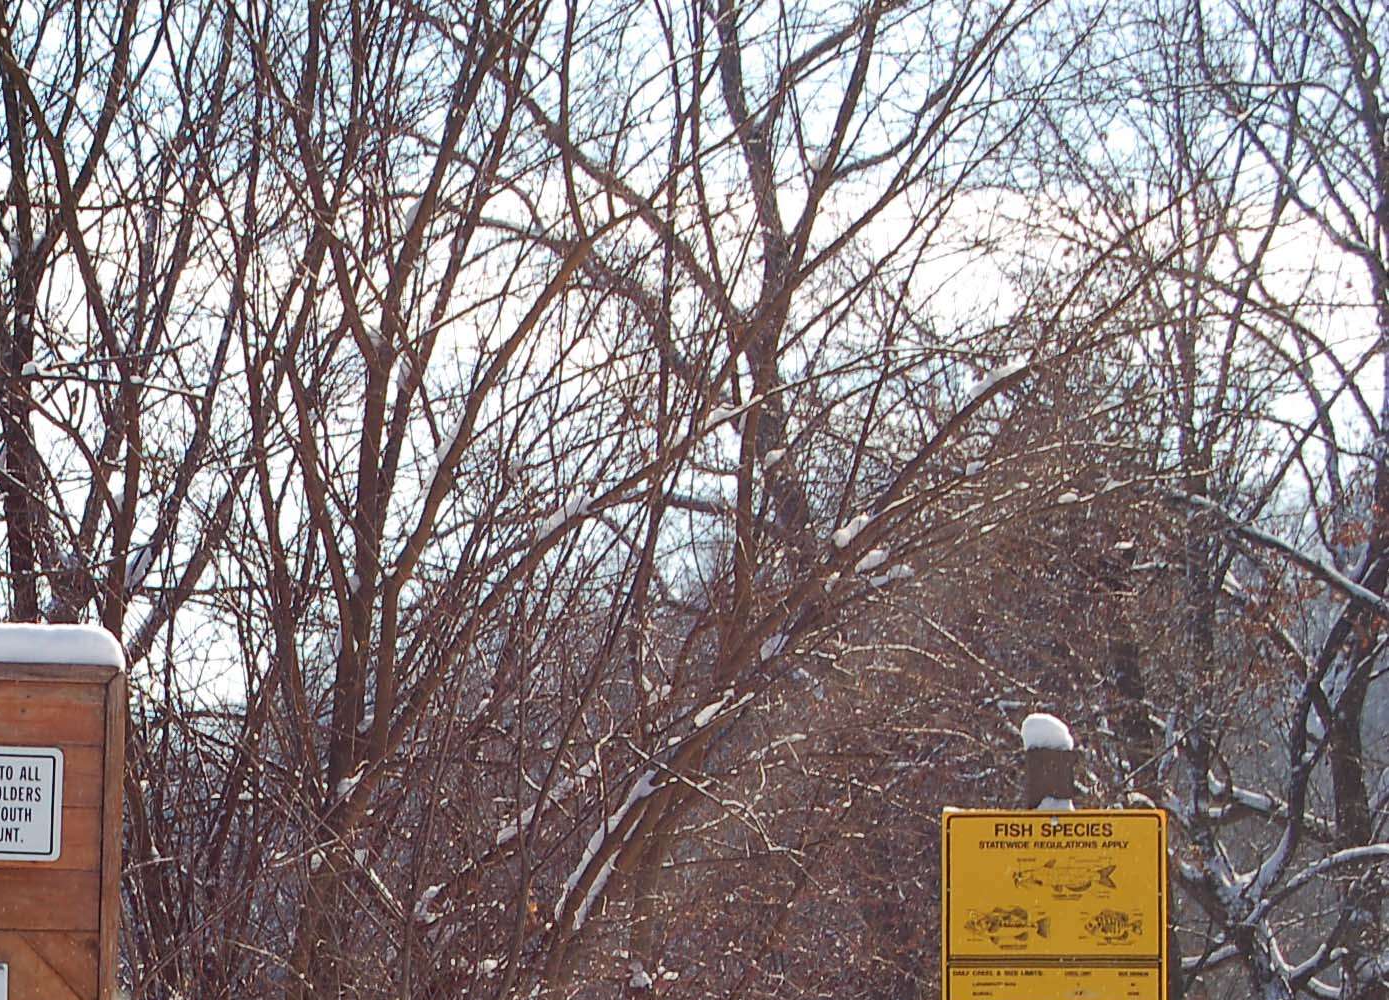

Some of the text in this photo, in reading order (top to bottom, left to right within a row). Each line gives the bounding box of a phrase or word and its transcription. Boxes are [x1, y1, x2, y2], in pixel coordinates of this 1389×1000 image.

[0, 766, 13, 781] TO
[19, 766, 41, 781] ALL
[994, 823, 1113, 838] FISH SPECIES
[979, 841, 1129, 849] STATEWIDE REGULATIONS APPLY
